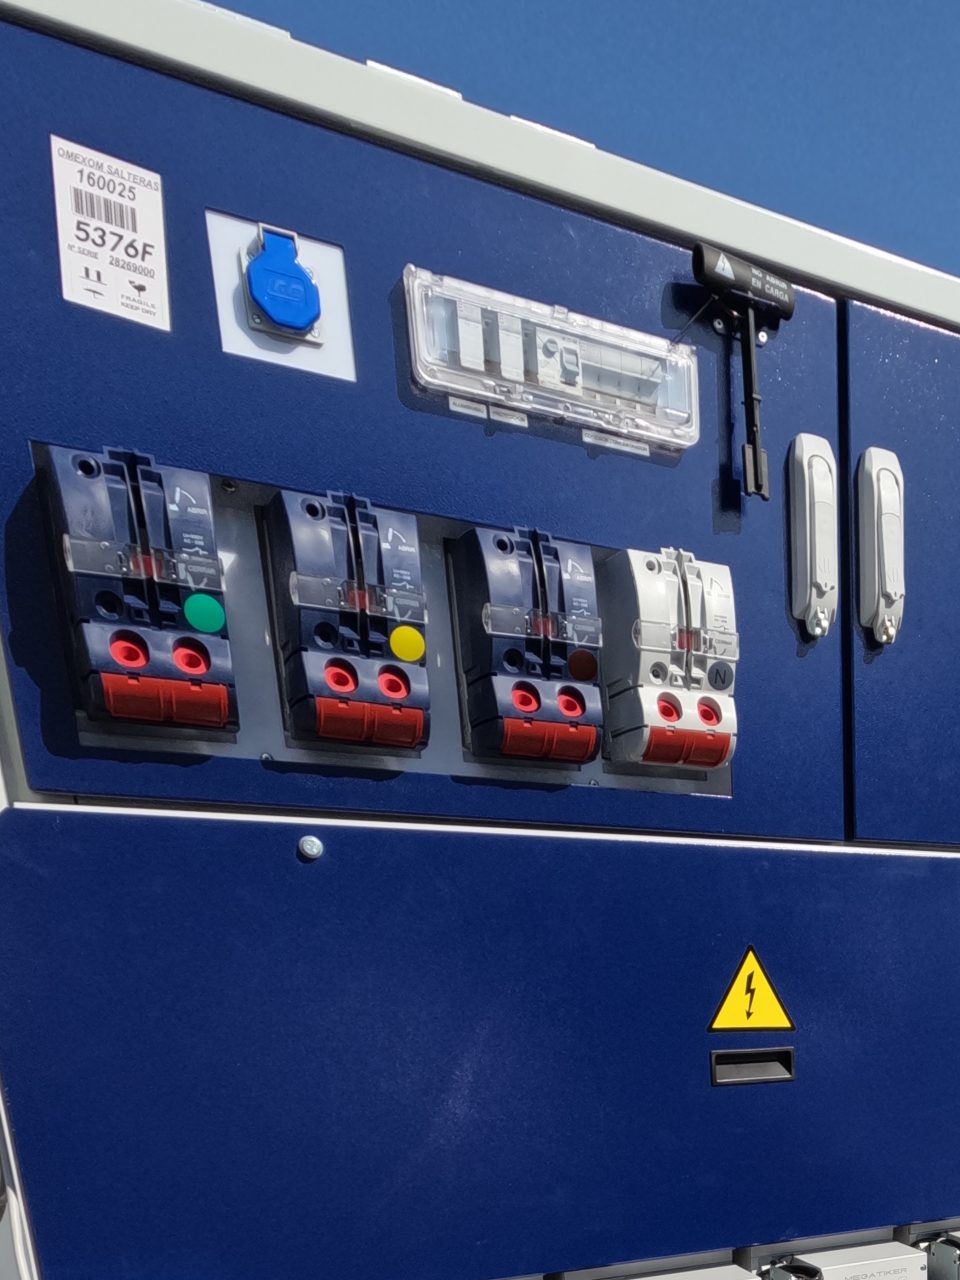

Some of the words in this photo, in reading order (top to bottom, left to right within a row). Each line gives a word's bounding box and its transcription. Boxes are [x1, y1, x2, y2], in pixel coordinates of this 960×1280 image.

[57, 147, 104, 172] OMEXOM
[106, 165, 159, 192] SALTERAS
[77, 168, 136, 201] 160025
[74, 220, 155, 262] 5376F
[109, 255, 155, 279] 28269000
[121, 294, 155, 309] FRAGILE
[751, 277, 762, 289] EN
[764, 284, 789, 303] CARGA
[714, 668, 727, 685] N
